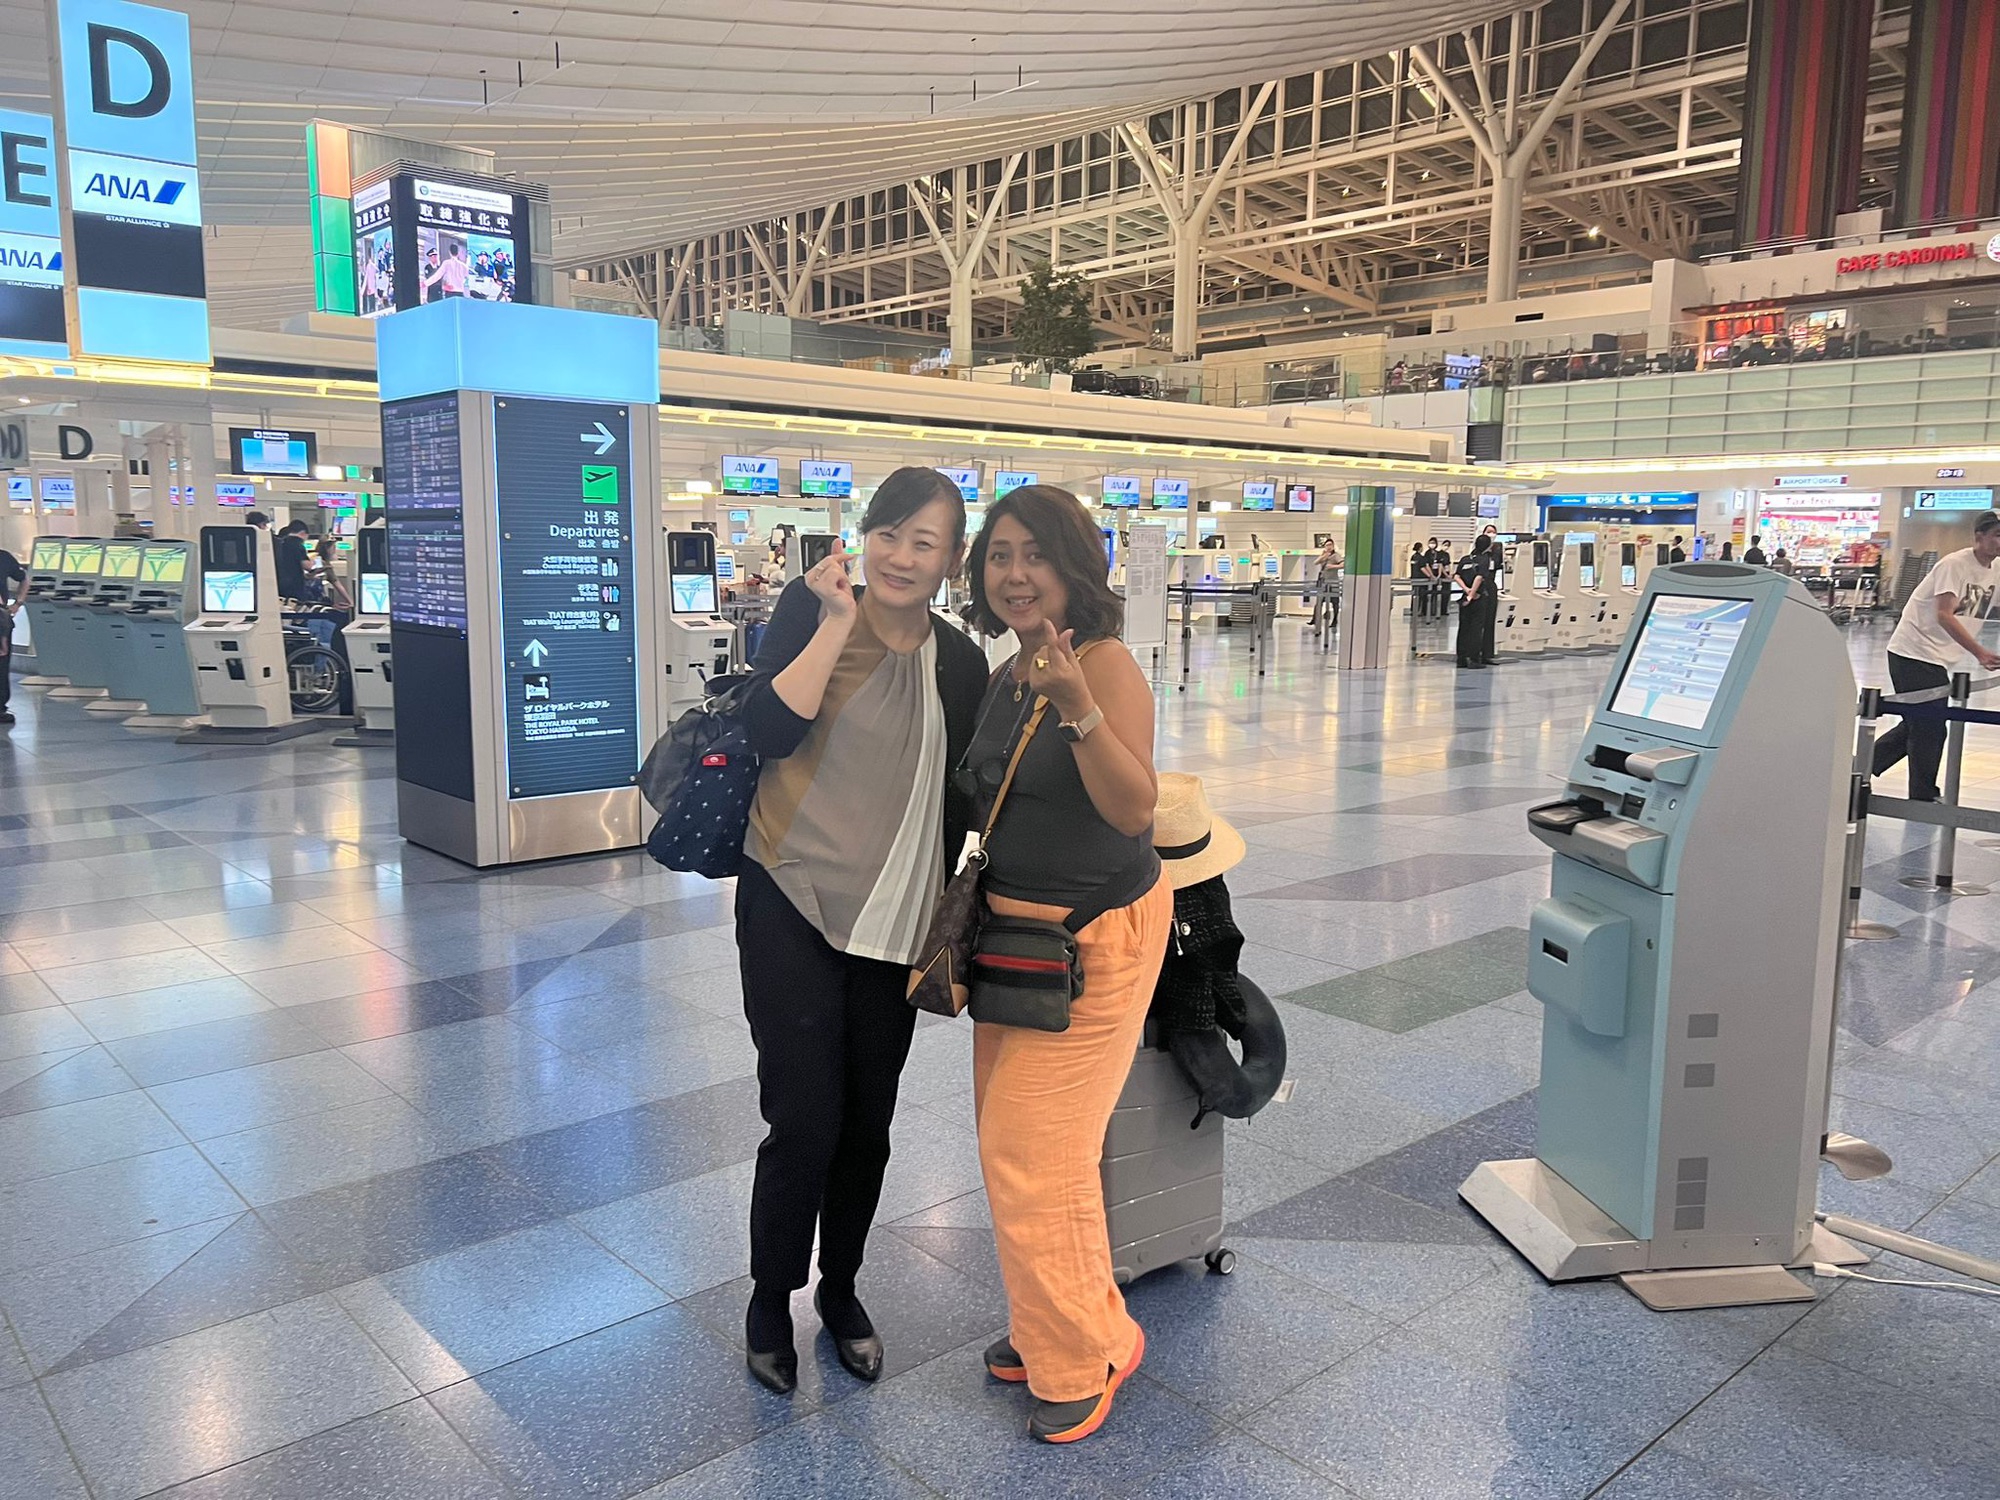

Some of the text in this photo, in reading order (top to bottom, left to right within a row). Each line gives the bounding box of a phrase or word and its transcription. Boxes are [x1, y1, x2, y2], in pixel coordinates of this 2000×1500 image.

[87, 22, 171, 118] D
[1, 131, 52, 207] E
[84, 173, 151, 202] ANA
[106, 215, 162, 228] STAR ALLIANCE
[1836, 242, 1977, 274] CAFE CARDINAL
[58, 425, 93, 460] D
[734, 463, 756, 473] ANA
[811, 467, 832, 477] ANA
[584, 510, 619, 525] 出発
[550, 525, 620, 539] Departures
